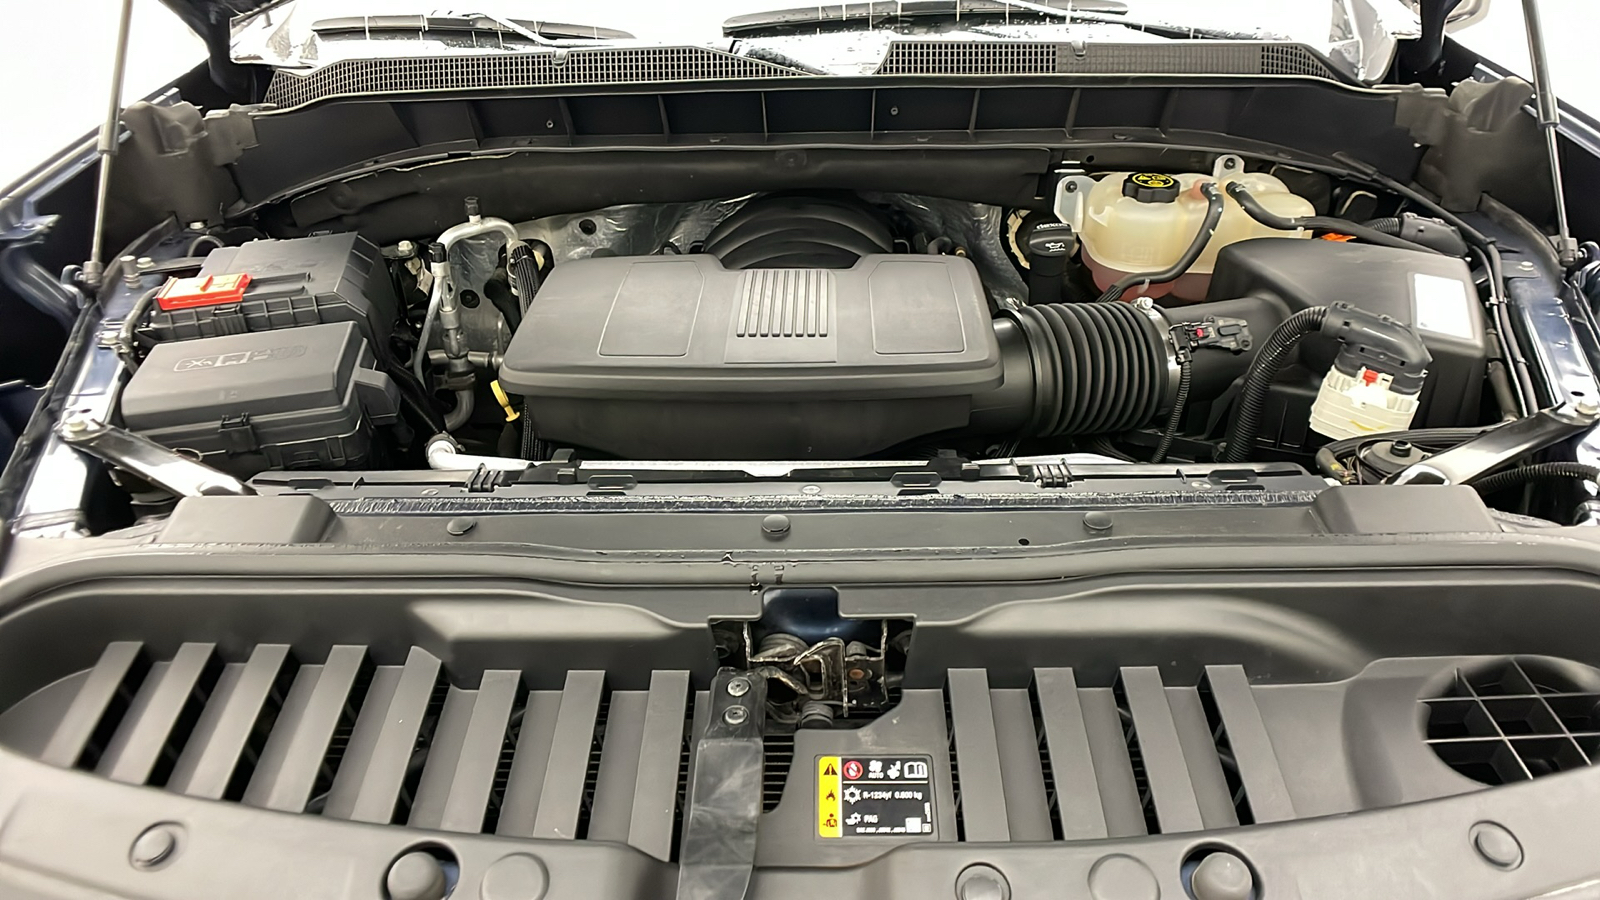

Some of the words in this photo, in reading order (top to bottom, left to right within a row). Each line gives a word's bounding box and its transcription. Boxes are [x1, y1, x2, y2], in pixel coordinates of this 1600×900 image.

[862, 791, 892, 800] R-1234yf
[913, 791, 922, 800] kg
[863, 814, 878, 823] PAG
